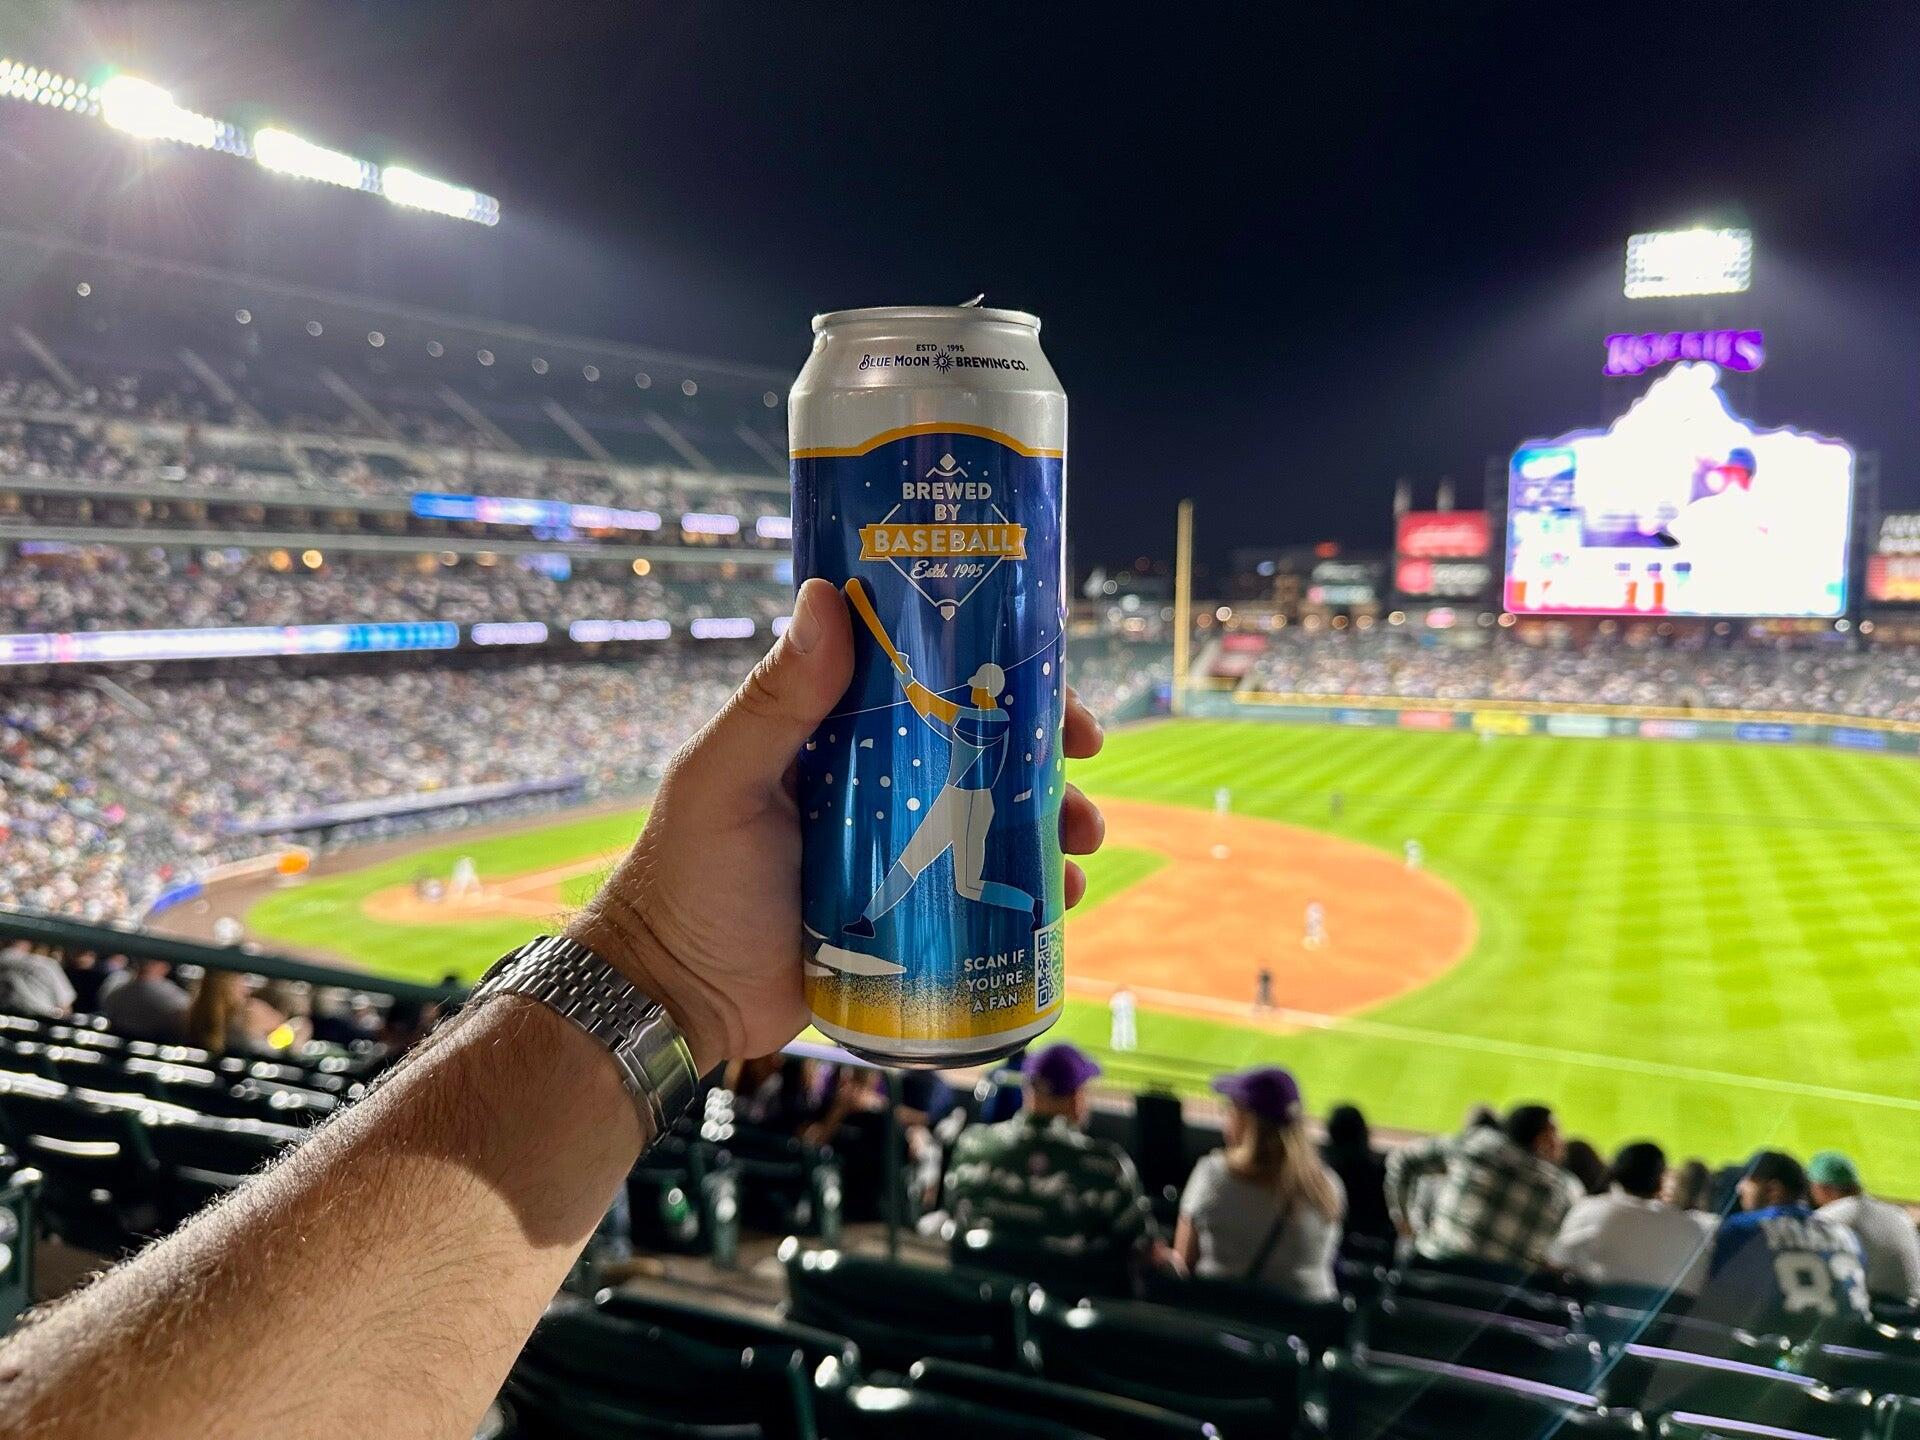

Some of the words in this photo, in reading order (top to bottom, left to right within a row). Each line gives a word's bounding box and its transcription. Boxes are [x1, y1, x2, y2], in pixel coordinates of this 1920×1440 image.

[916, 344, 938, 352] ESTD
[946, 344, 965, 352] 1995
[956, 357, 1010, 369] BREWING
[1011, 360, 1029, 371] CO.
[902, 482, 992, 500] BREWED
[934, 503, 962, 521] BY
[874, 529, 1013, 553] BASEBALL
[952, 563, 985, 578] 1995
[964, 953, 1007, 972] SCAN
[1013, 949, 1025, 963] IF
[966, 970, 1022, 992] YOU'RE
[972, 1000, 984, 1013] A
[989, 992, 1018, 1010] FAN
